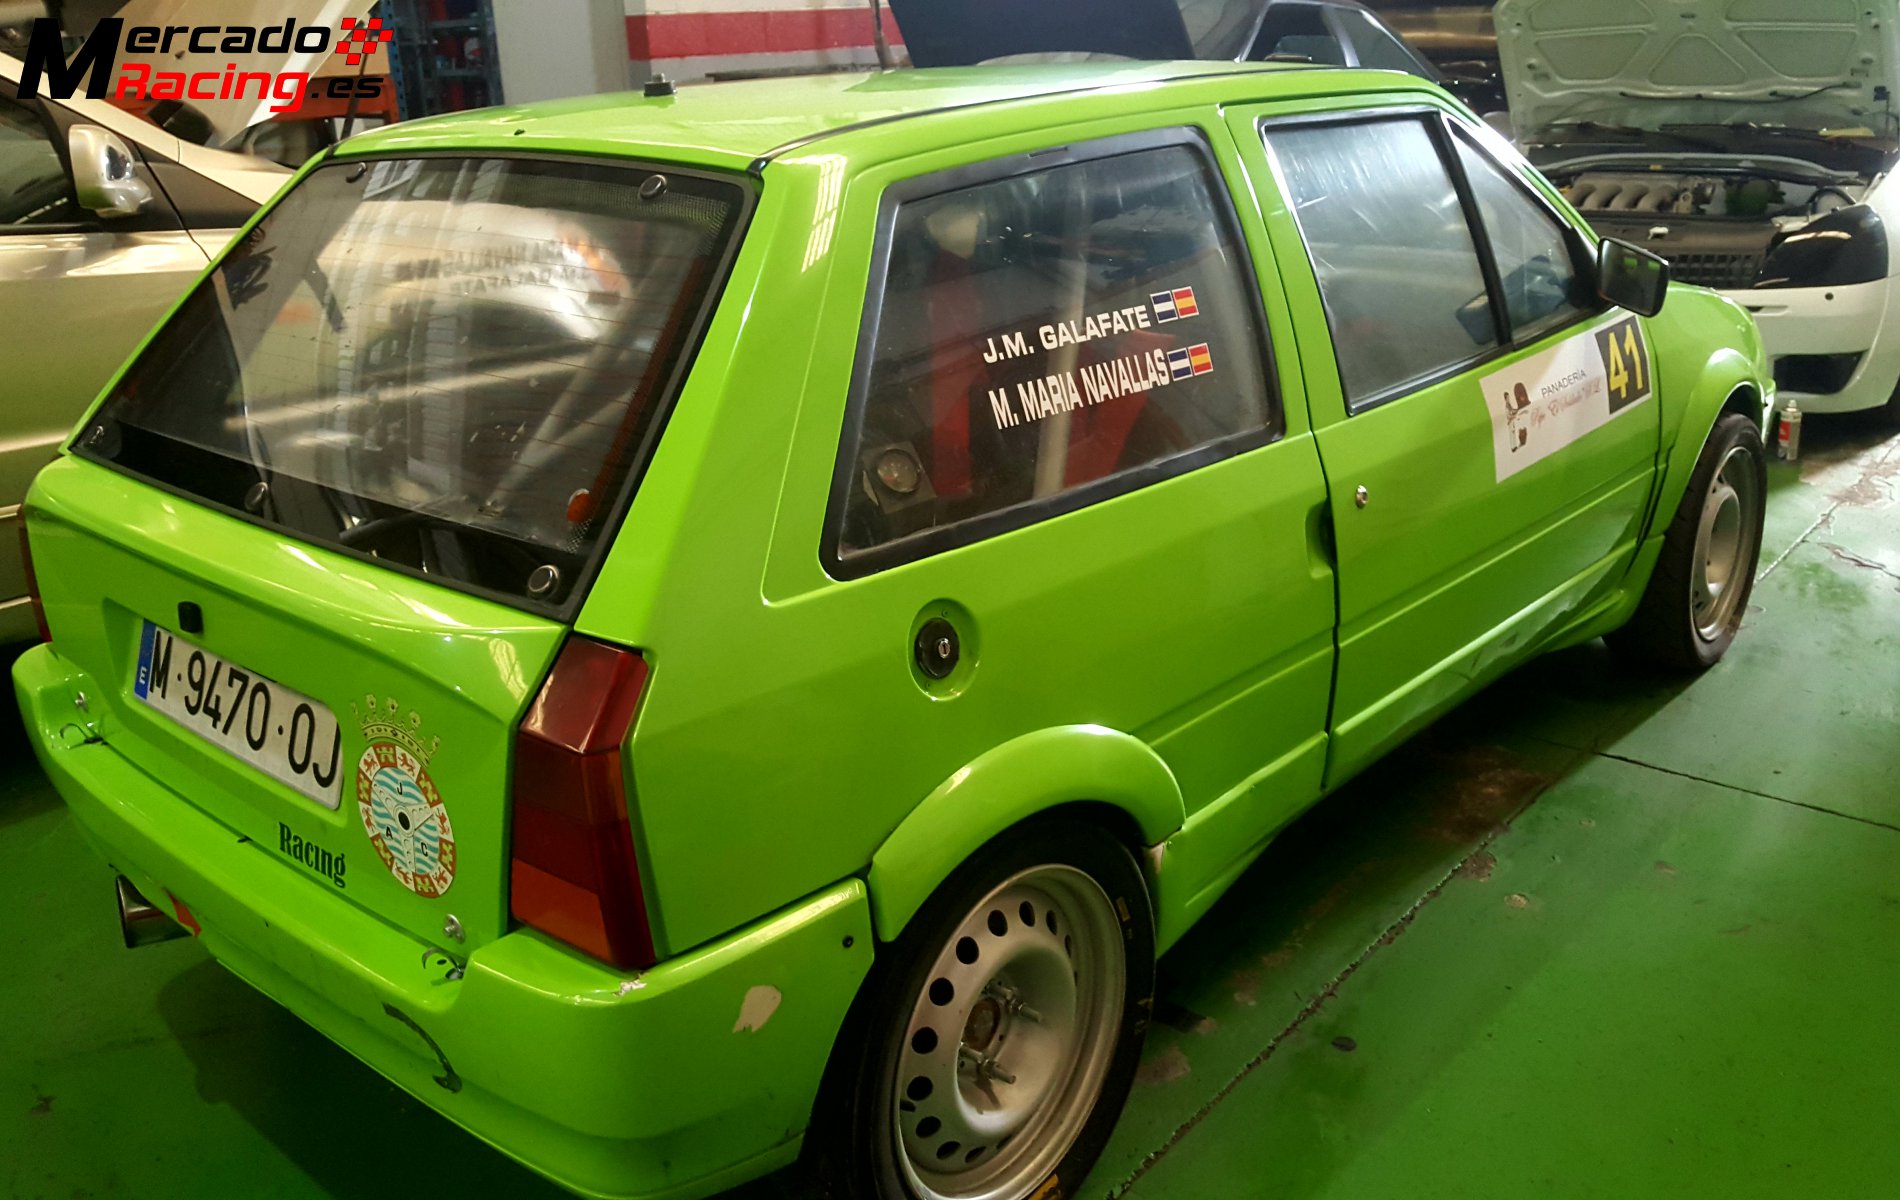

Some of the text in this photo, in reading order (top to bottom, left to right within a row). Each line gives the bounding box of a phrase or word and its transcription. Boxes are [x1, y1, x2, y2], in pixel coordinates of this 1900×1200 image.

[982, 305, 1151, 364] J.M. GALAFATE
[1608, 324, 1643, 398] 41
[988, 348, 1170, 430] M. MARIA NAVALLAS
[278, 821, 346, 889] Racing
